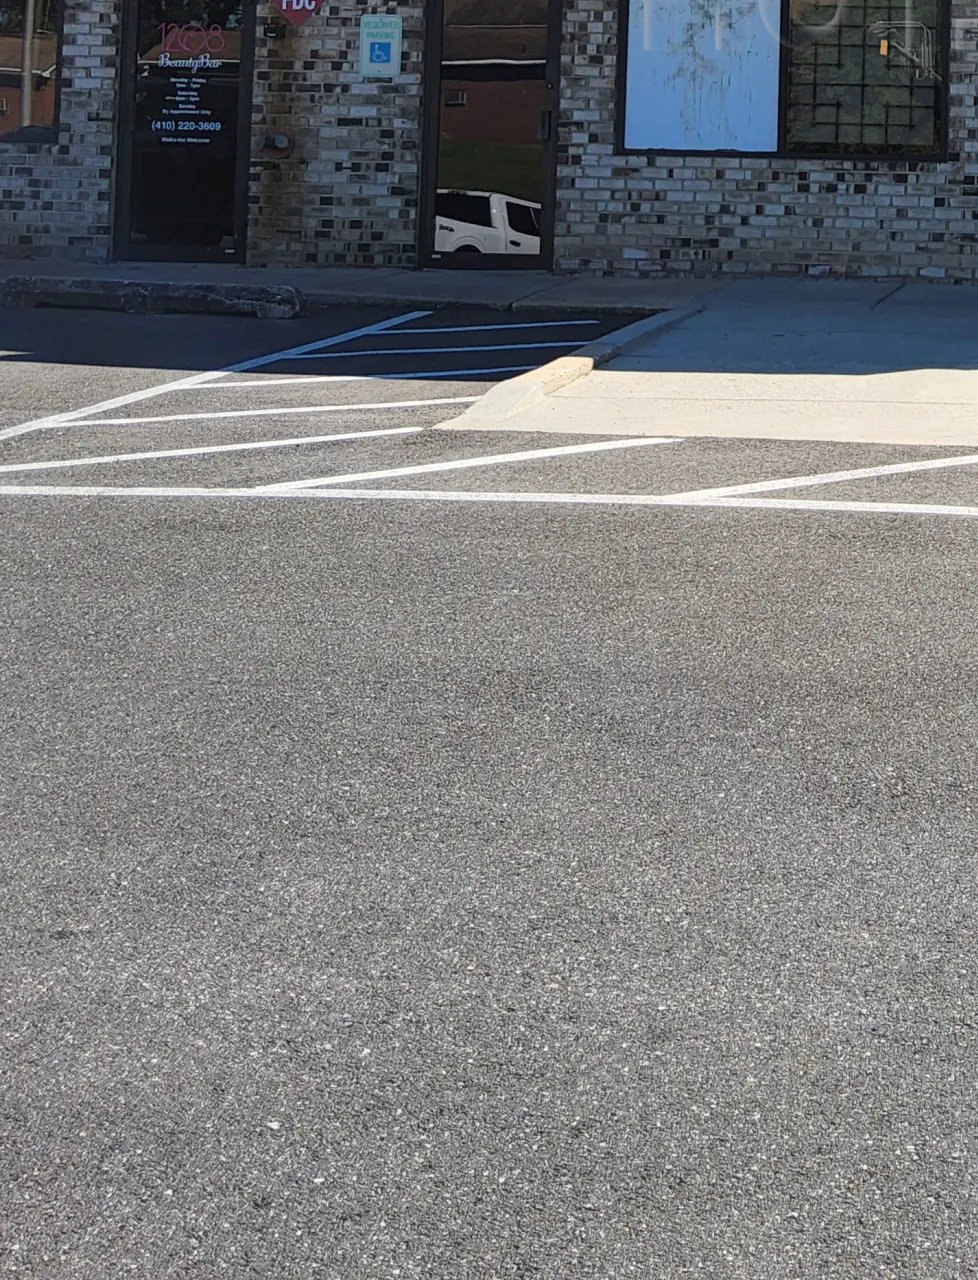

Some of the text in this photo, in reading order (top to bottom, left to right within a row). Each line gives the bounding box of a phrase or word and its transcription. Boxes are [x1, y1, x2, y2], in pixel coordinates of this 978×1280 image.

[363, 21, 399, 29] RESERVED
[366, 31, 395, 39] PARKING
[151, 120, 176, 132] (410)
